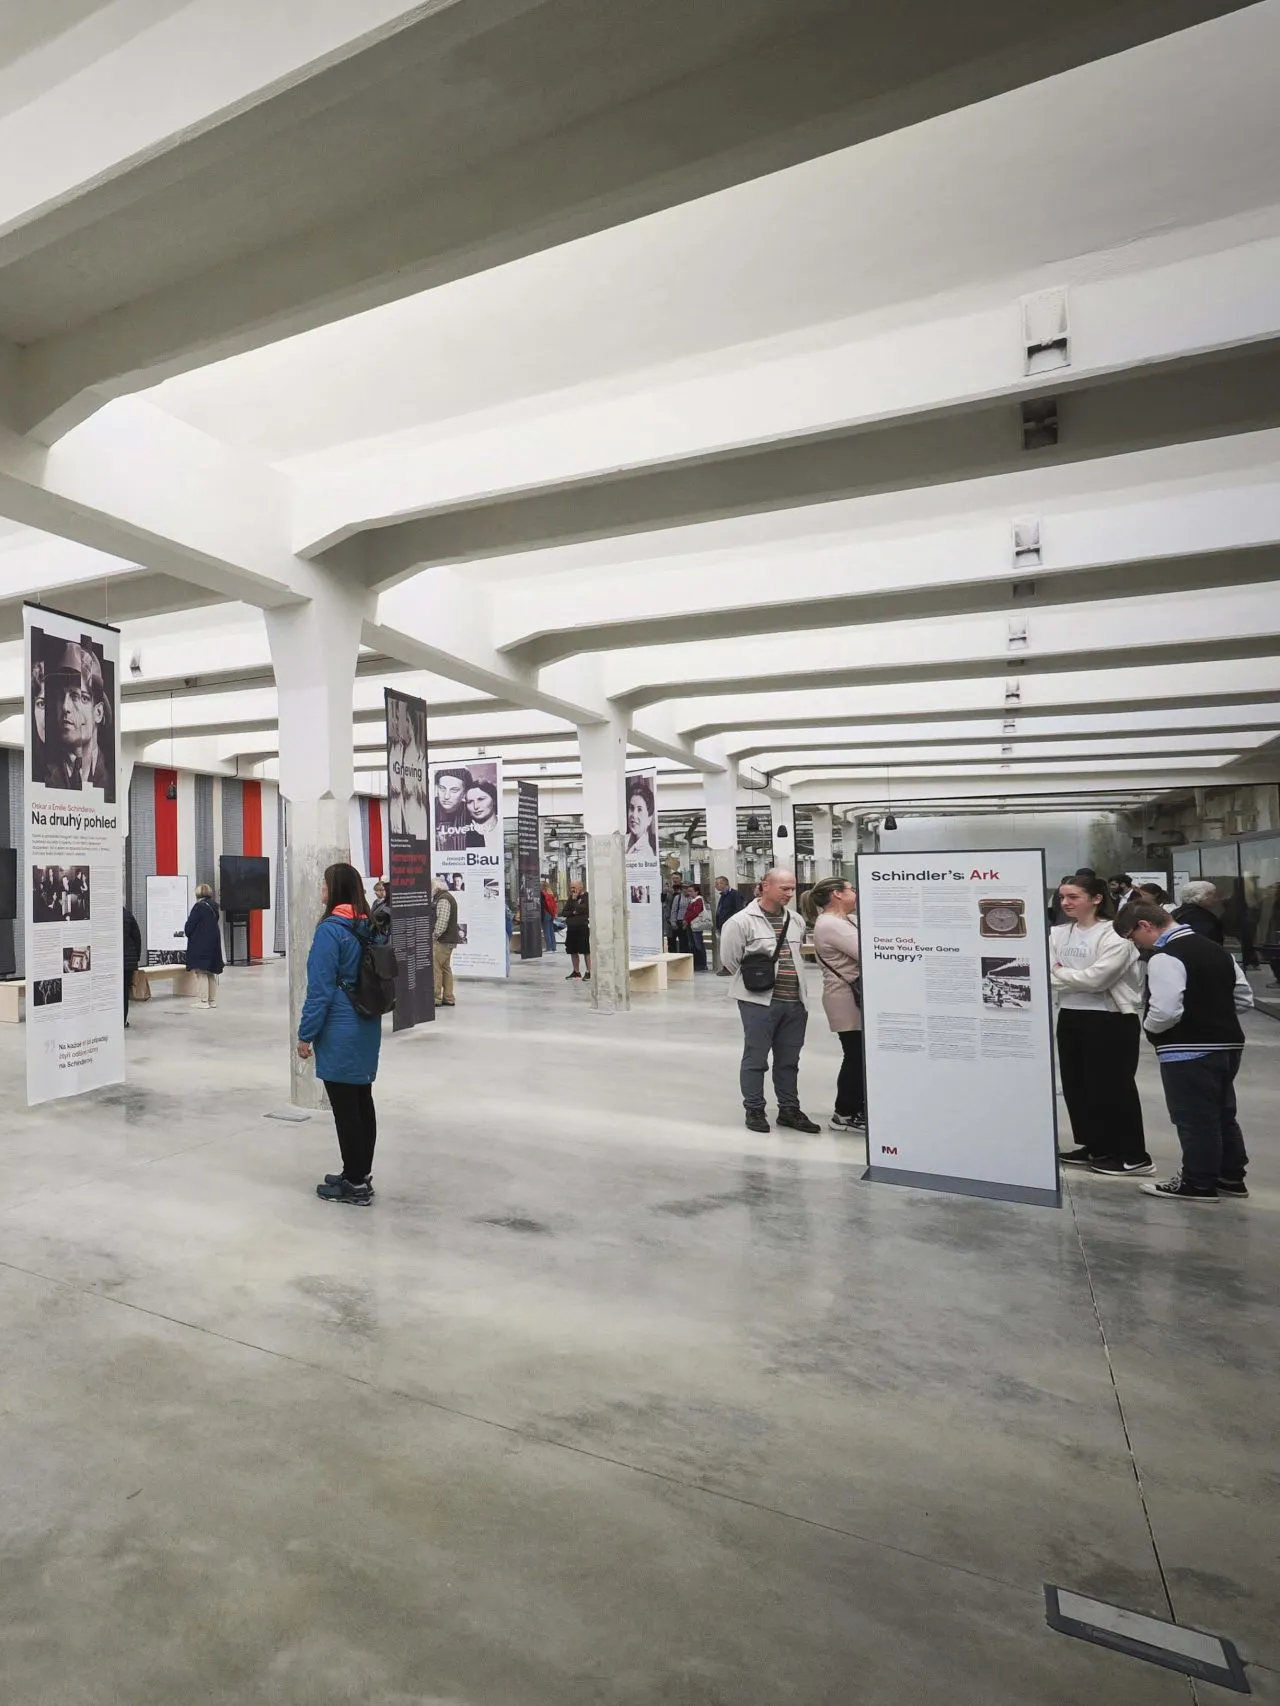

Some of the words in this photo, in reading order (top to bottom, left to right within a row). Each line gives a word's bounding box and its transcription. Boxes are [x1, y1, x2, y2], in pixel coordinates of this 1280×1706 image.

[31, 811, 47, 825] Na
[49, 812, 82, 831] druhý
[84, 815, 116, 831] pohled
[970, 870, 1000, 880] Ark
[873, 936, 893, 944] Dear
[895, 937, 916, 945] God,
[874, 952, 923, 963] Hungry?
